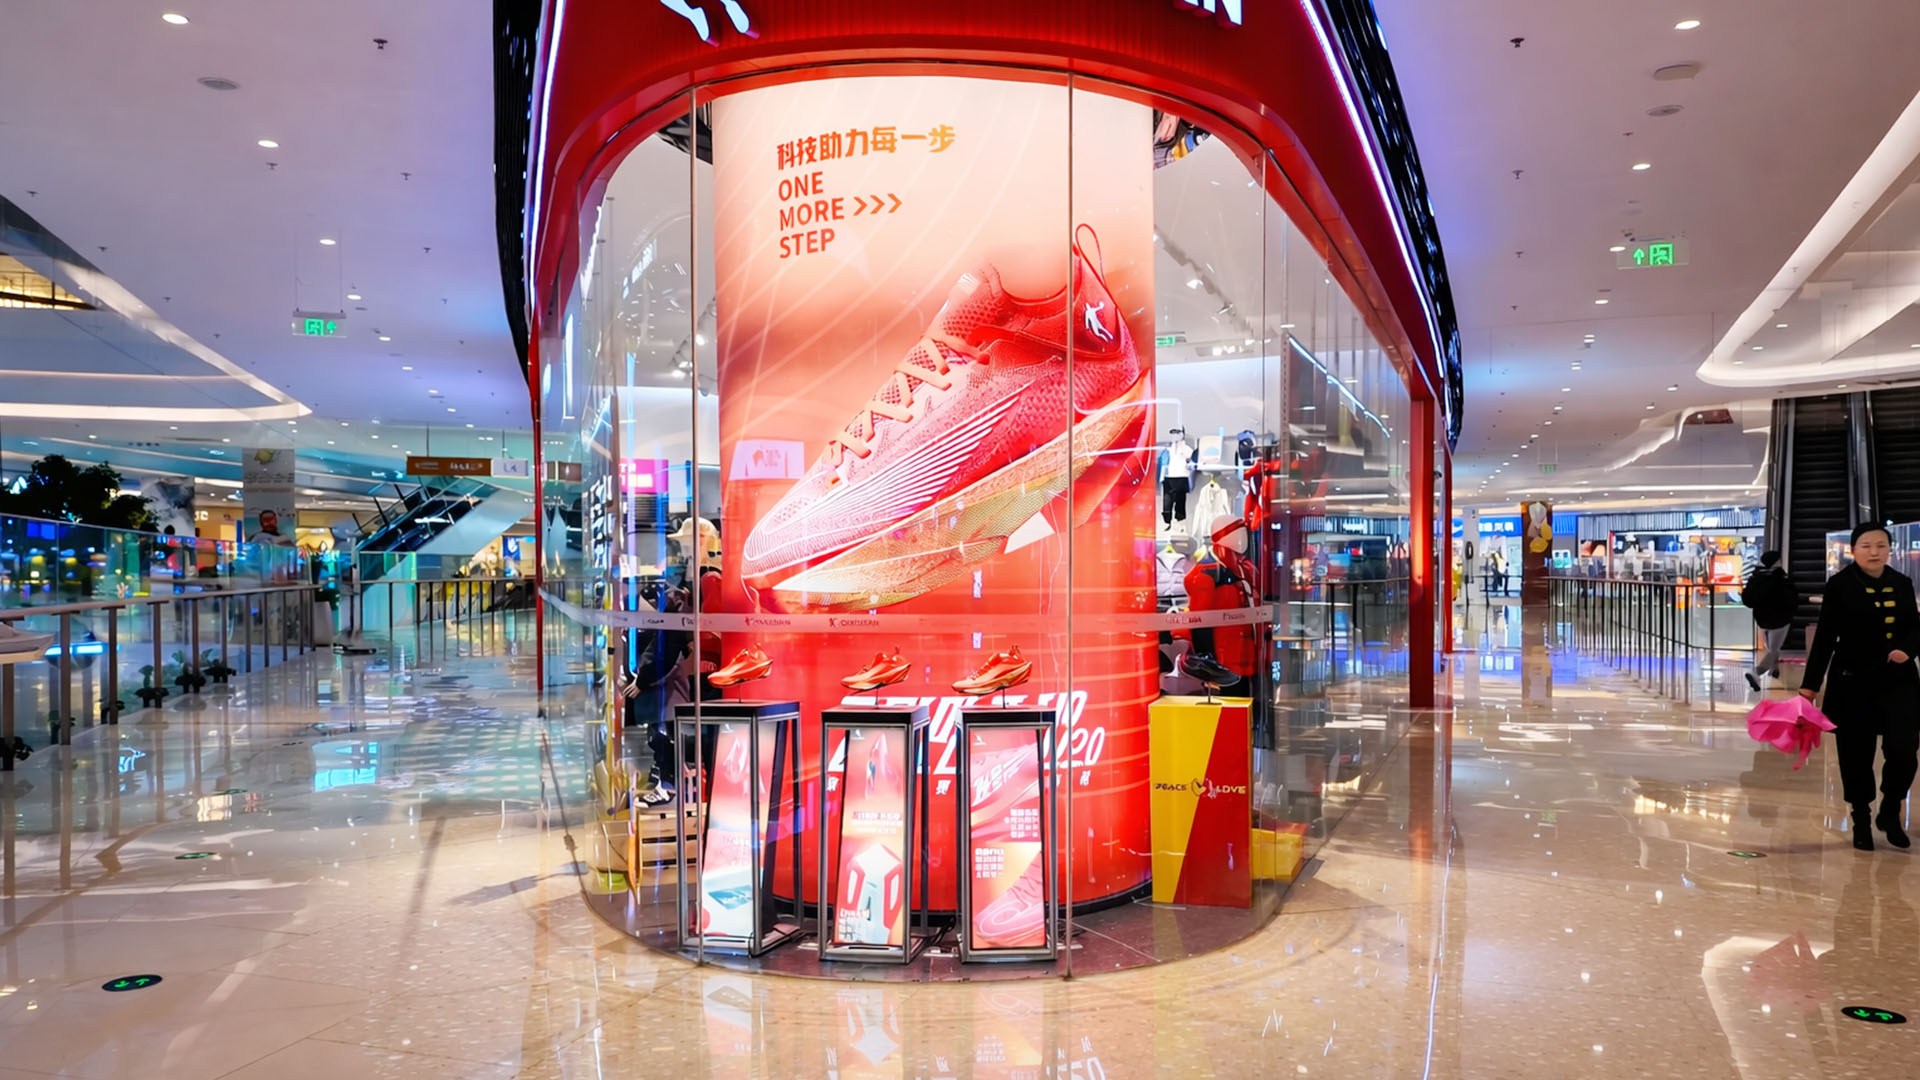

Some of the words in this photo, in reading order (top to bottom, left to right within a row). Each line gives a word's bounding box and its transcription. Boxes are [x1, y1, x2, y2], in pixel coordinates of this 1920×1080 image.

[777, 124, 956, 171] 科技助力每一步
[778, 171, 824, 201] ONE
[779, 197, 845, 231] MORE
[779, 228, 836, 259] STEP
[1216, 784, 1247, 794] LOVE
